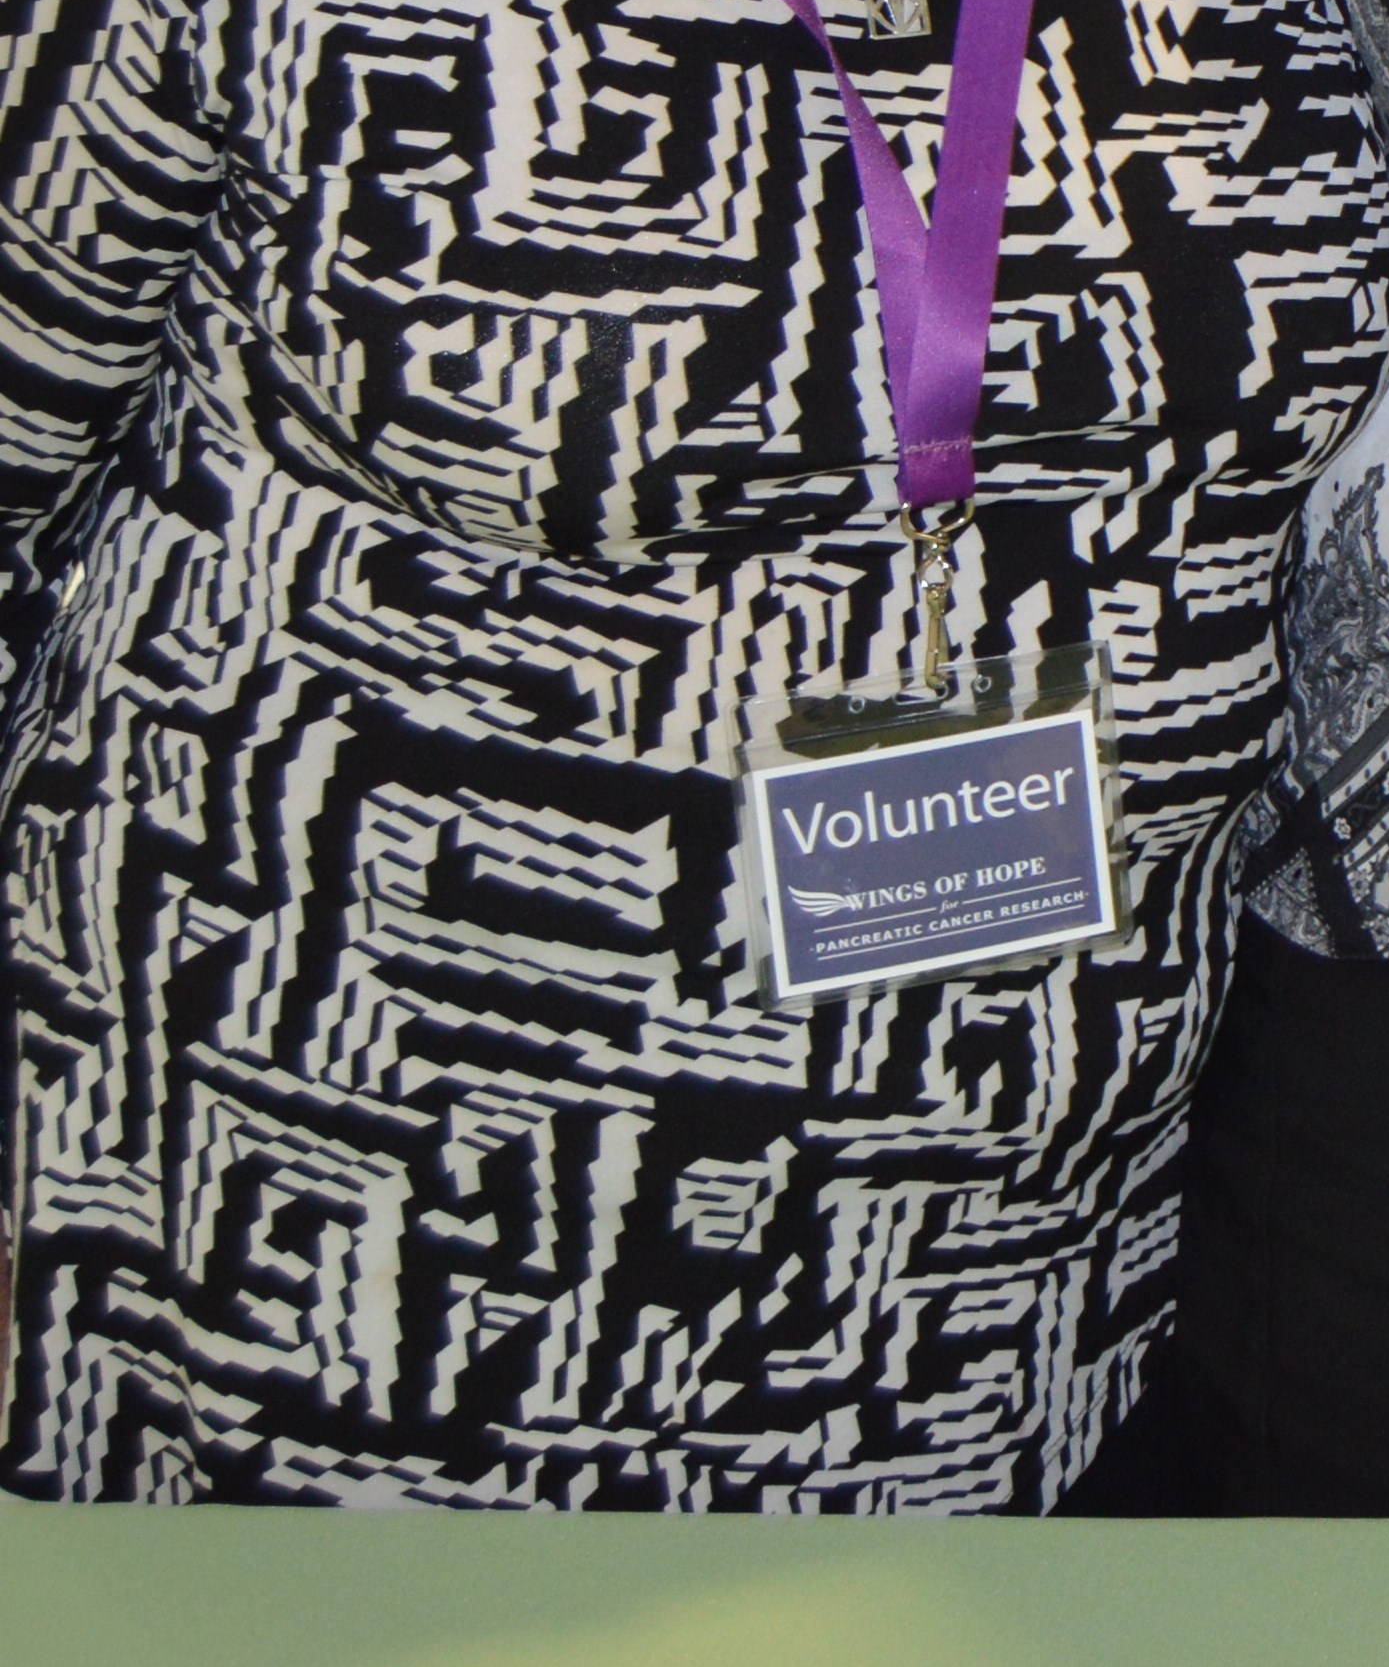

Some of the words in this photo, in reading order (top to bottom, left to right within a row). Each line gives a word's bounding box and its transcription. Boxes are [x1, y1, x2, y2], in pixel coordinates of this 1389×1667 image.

[782, 766, 1075, 855] Volunteer
[845, 880, 927, 912] WINGS
[934, 871, 968, 895] OF
[975, 856, 1046, 888] HOPE
[939, 899, 960, 914] for
[815, 924, 923, 954] PANCREATIC
[929, 909, 994, 932] CANCER
[1000, 890, 1085, 917] RESEARCH
